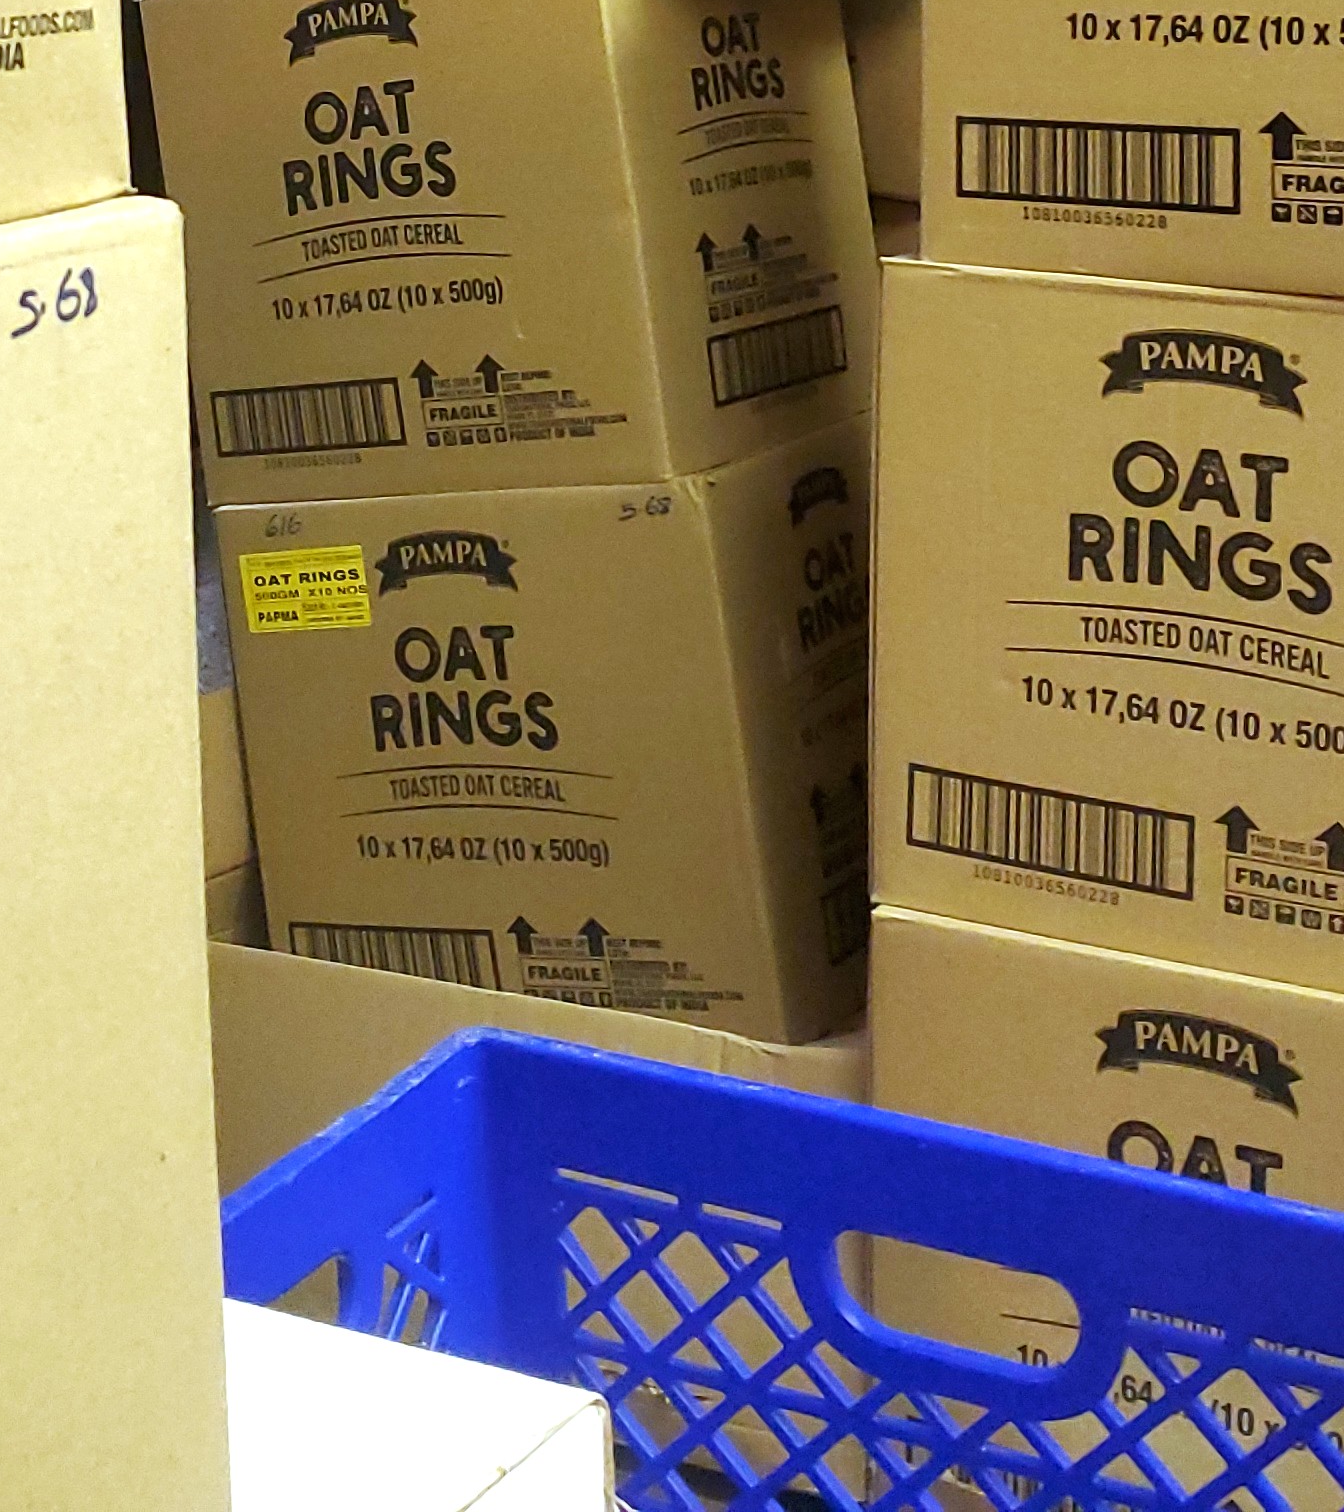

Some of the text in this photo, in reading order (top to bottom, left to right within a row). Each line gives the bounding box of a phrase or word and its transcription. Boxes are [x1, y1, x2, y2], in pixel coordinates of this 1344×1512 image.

[307, 1, 389, 37] PAMPA
[701, 12, 760, 57] OAT
[1066, 14, 1097, 41] 10
[1104, 19, 1121, 40] x
[1129, 16, 1204, 48] 17,64
[1211, 17, 1250, 43] OZ
[1259, 15, 1306, 52] (10
[1312, 27, 1331, 48] x
[690, 57, 785, 111] RINGS
[304, 79, 415, 145] OAT
[283, 141, 456, 217] RINGS
[301, 222, 463, 261] TOASTED OAT CEREAL
[1137, 342, 1264, 382] PAMPA
[429, 403, 497, 424] FRAGILE
[1112, 440, 1289, 523] OAT
[400, 540, 486, 570] PAMPA
[1068, 513, 1333, 615] RINGS
[254, 569, 360, 586] OAT RINGS
[337, 585, 368, 595] NOS
[394, 625, 514, 683] OAT
[1080, 618, 1329, 681] TOASTED OAT CEREAL
[370, 690, 558, 752] RINGS
[390, 775, 566, 802] TOASTED OAT CEREAL
[1234, 867, 1340, 902] FRAGILE
[528, 964, 603, 983] FRAGILE
[1134, 1020, 1259, 1076] PAMPA
